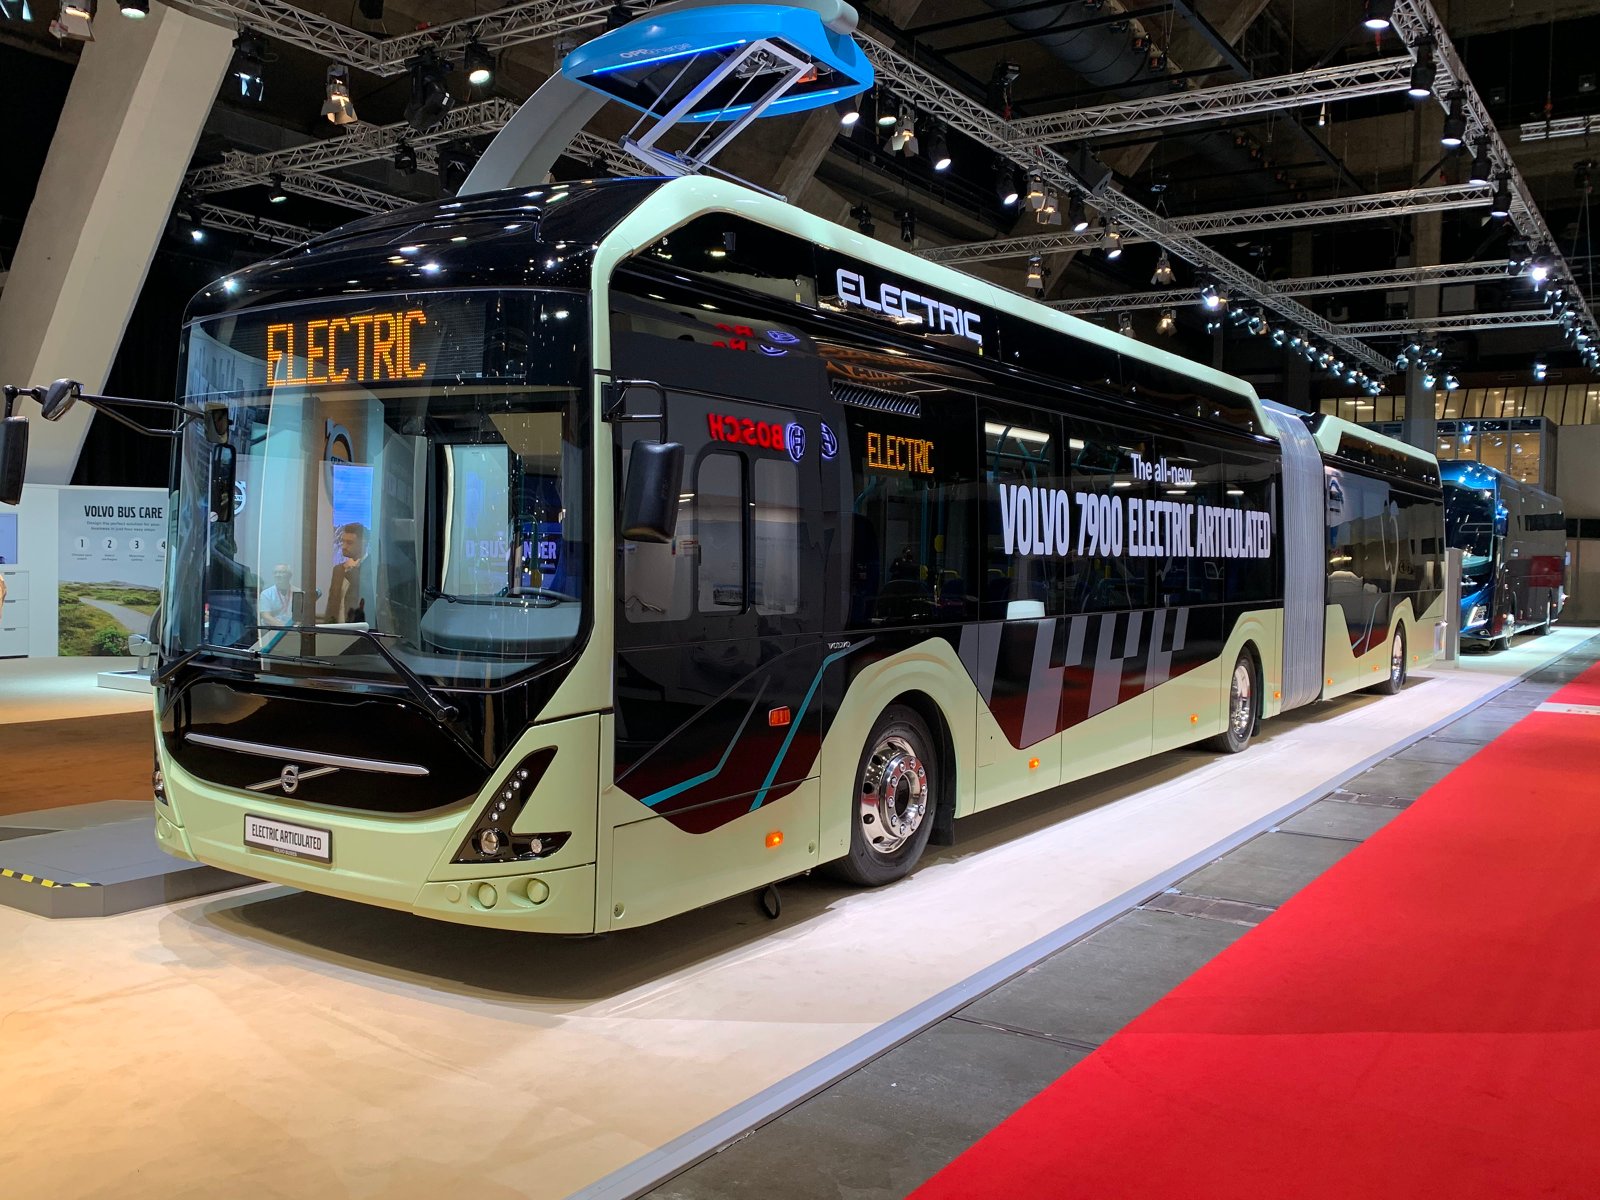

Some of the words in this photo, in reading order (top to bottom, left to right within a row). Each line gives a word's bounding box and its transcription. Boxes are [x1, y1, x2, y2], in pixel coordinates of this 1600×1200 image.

[836, 268, 983, 343] ELECTRIC
[267, 310, 427, 387] ELECTRIC
[867, 432, 935, 474] ELECTRIC
[1130, 453, 1152, 481] The
[1154, 457, 1193, 485] all-new
[84, 505, 114, 518] VOLVO
[117, 506, 136, 518] BUS
[139, 507, 163, 519] CARE
[1000, 484, 1070, 556] VOLVO
[1075, 492, 1123, 557] 7900
[1128, 497, 1195, 558] ELECTRIC
[1196, 504, 1271, 559] ARTICULATED
[107, 539, 112, 549] 2
[134, 540, 139, 549] 3
[161, 541, 166, 550] 4
[828, 641, 850, 649] VOLVO
[252, 823, 279, 841] ELECTRIC
[279, 829, 322, 851] ARTICULATED
